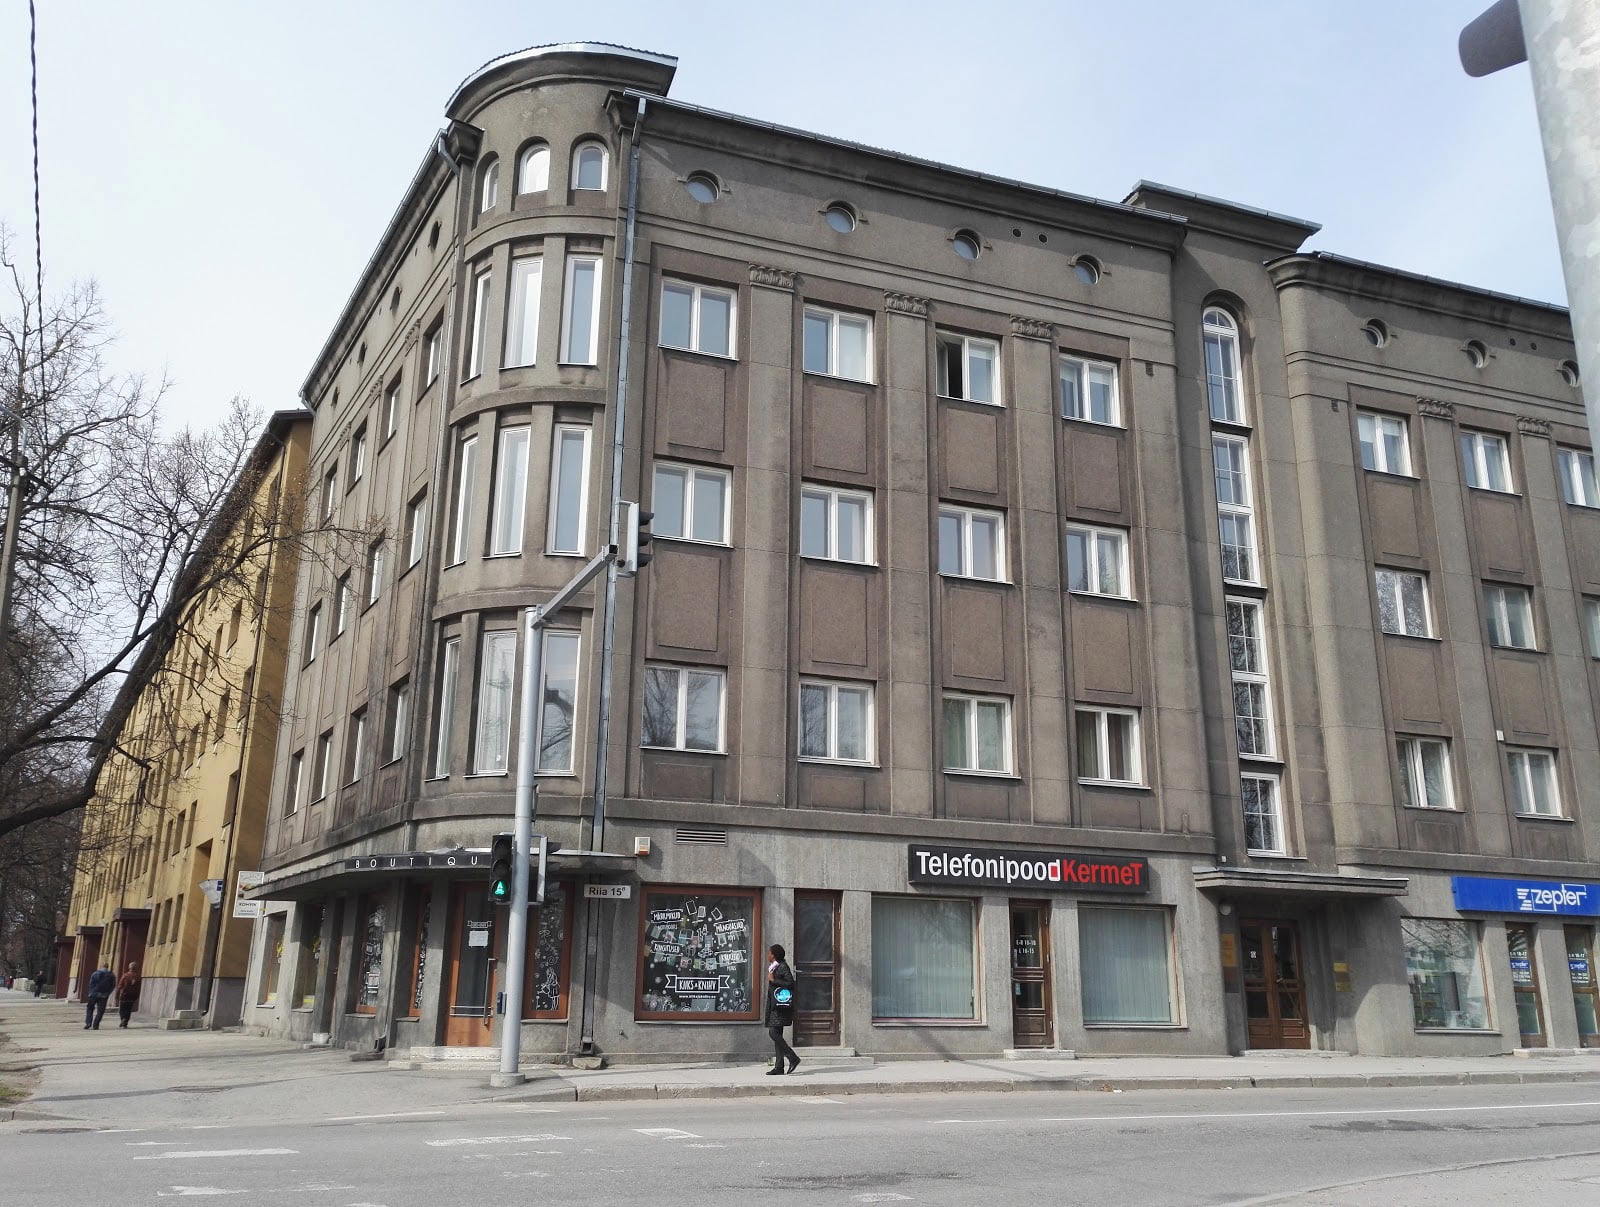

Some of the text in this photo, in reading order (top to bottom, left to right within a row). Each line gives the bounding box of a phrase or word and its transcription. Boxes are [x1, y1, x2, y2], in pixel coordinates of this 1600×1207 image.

[355, 856, 478, 868] BOUTIQU
[916, 851, 1060, 883] Telefonipood
[589, 887, 608, 896] Riia
[1530, 883, 1587, 912] zepter
